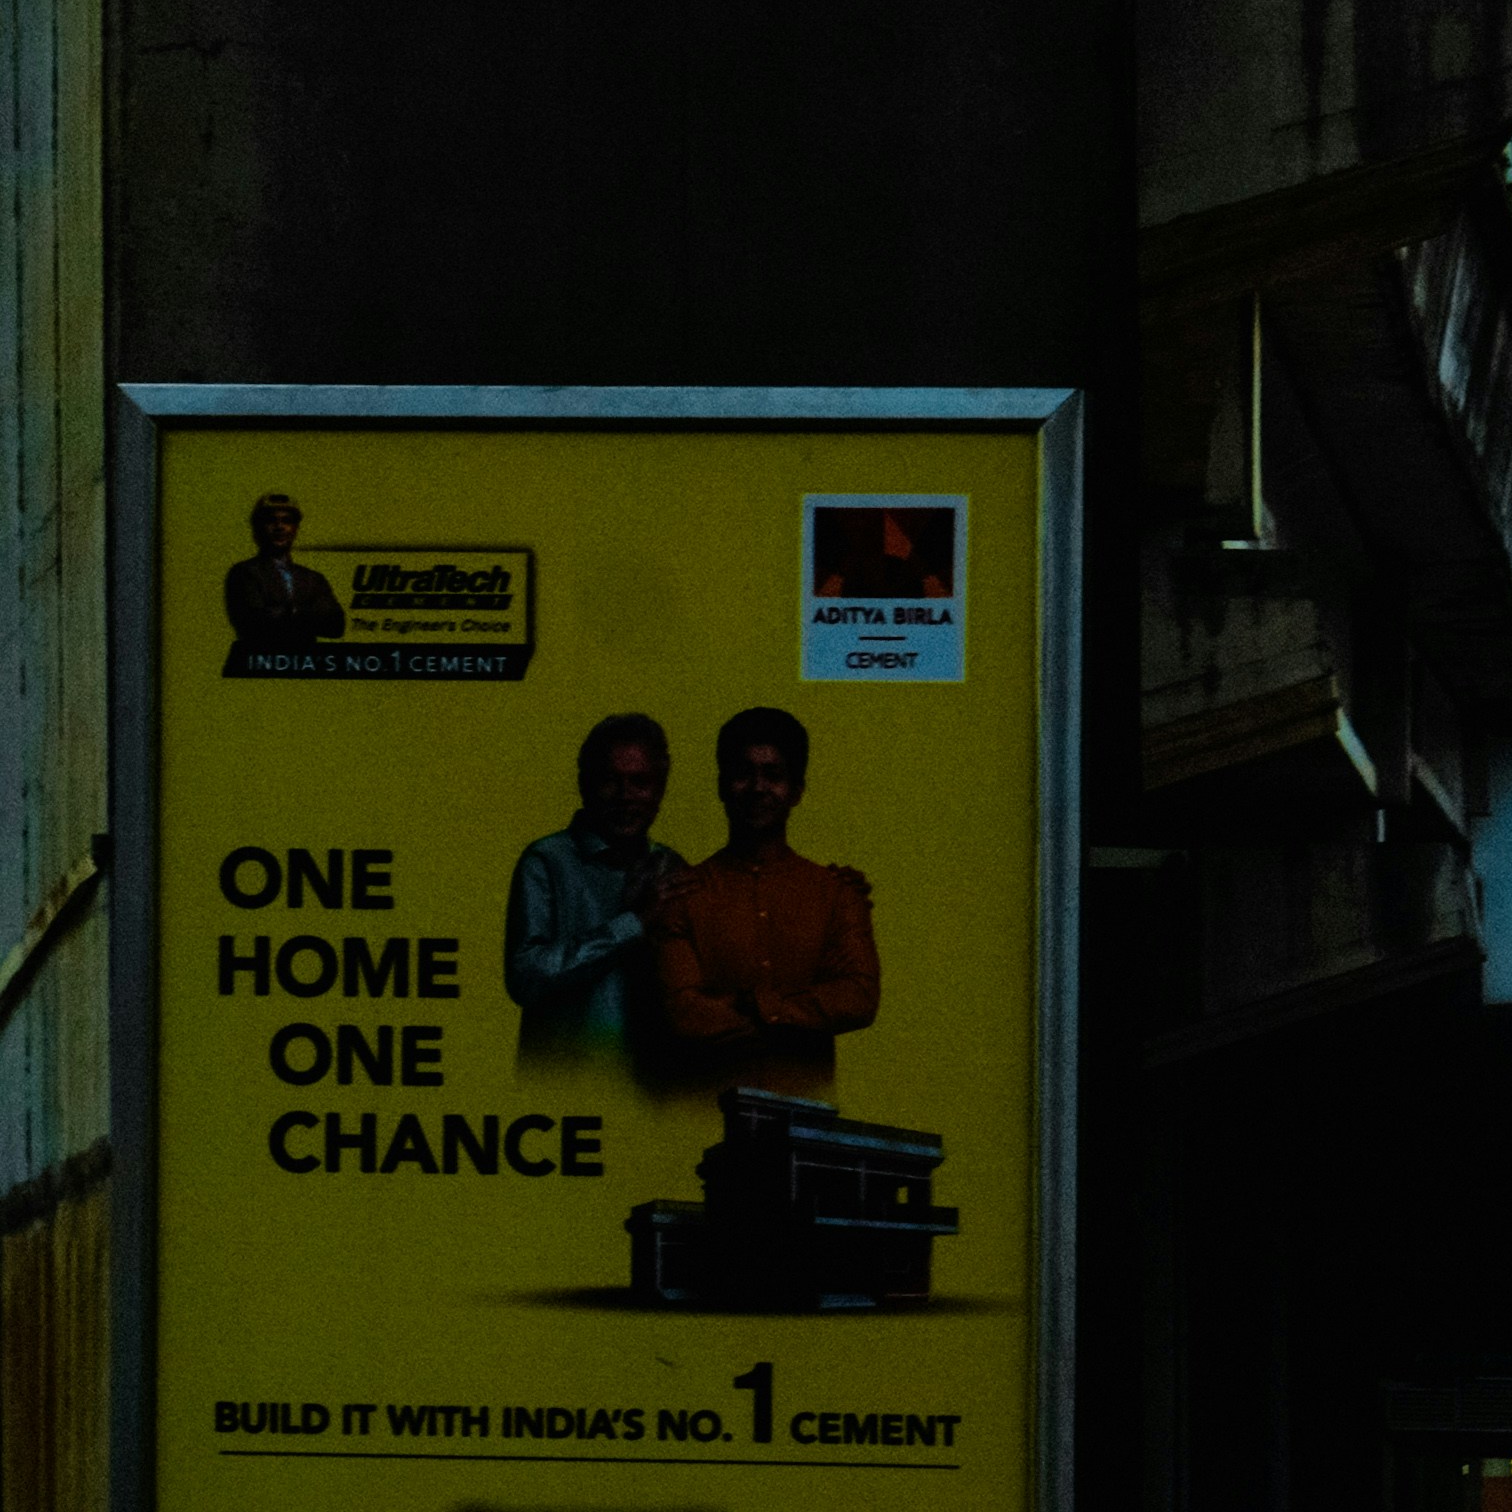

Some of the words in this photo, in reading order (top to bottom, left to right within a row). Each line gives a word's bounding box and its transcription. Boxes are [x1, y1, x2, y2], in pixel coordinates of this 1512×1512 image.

[353, 564, 511, 592] UltraTech
[814, 607, 886, 625] ADITYA
[894, 607, 954, 625] BIRLA
[249, 652, 338, 673] INDIA'S
[408, 654, 508, 674] CEMENT
[845, 651, 919, 669] CEMENT
[219, 846, 394, 910] ONE
[219, 935, 459, 999] HOME
[269, 1022, 443, 1086] ONE
[269, 1110, 604, 1177] CHANCE
[215, 1401, 329, 1435] BUILD
[343, 1404, 377, 1436] IT
[387, 1404, 490, 1438] WITH
[503, 1406, 645, 1441] INDIA'S
[790, 1410, 962, 1447] CEMENT
